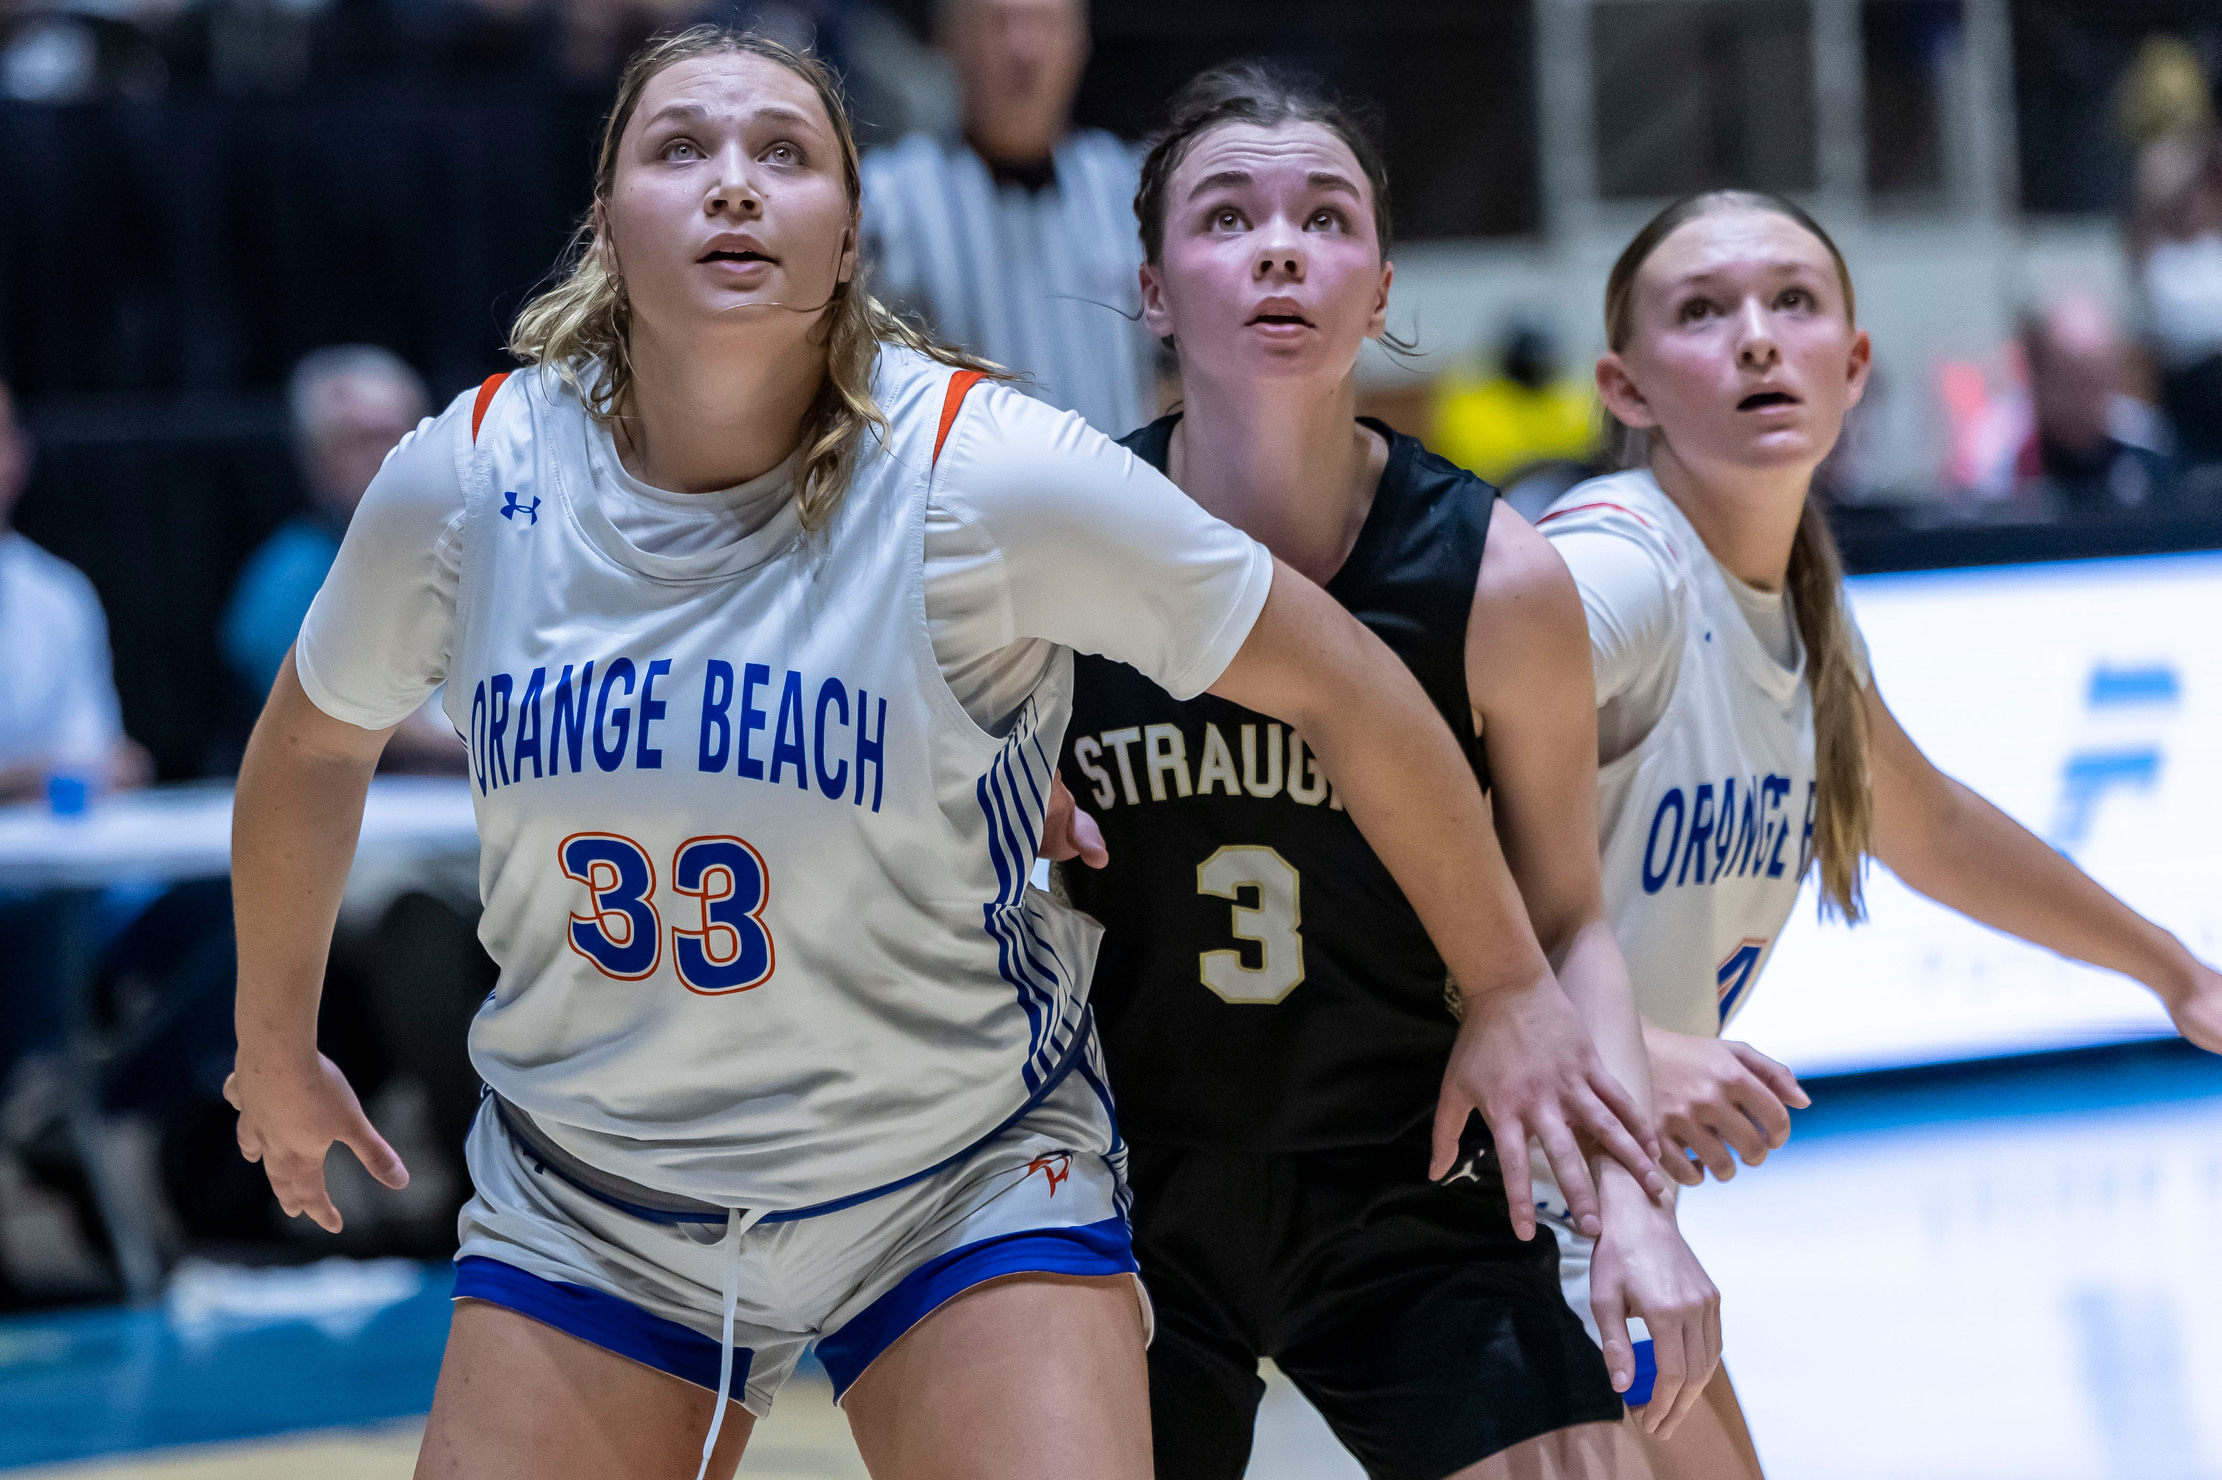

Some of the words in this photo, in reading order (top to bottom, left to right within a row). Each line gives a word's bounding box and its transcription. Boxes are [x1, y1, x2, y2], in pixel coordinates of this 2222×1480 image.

[471, 657, 672, 797] ORANGE
[698, 659, 887, 813] BEACH
[1074, 722, 1344, 811] STRAUG
[1642, 773, 1790, 895] ORANGE
[557, 831, 775, 996] 33
[1196, 844, 1305, 1005] 3
